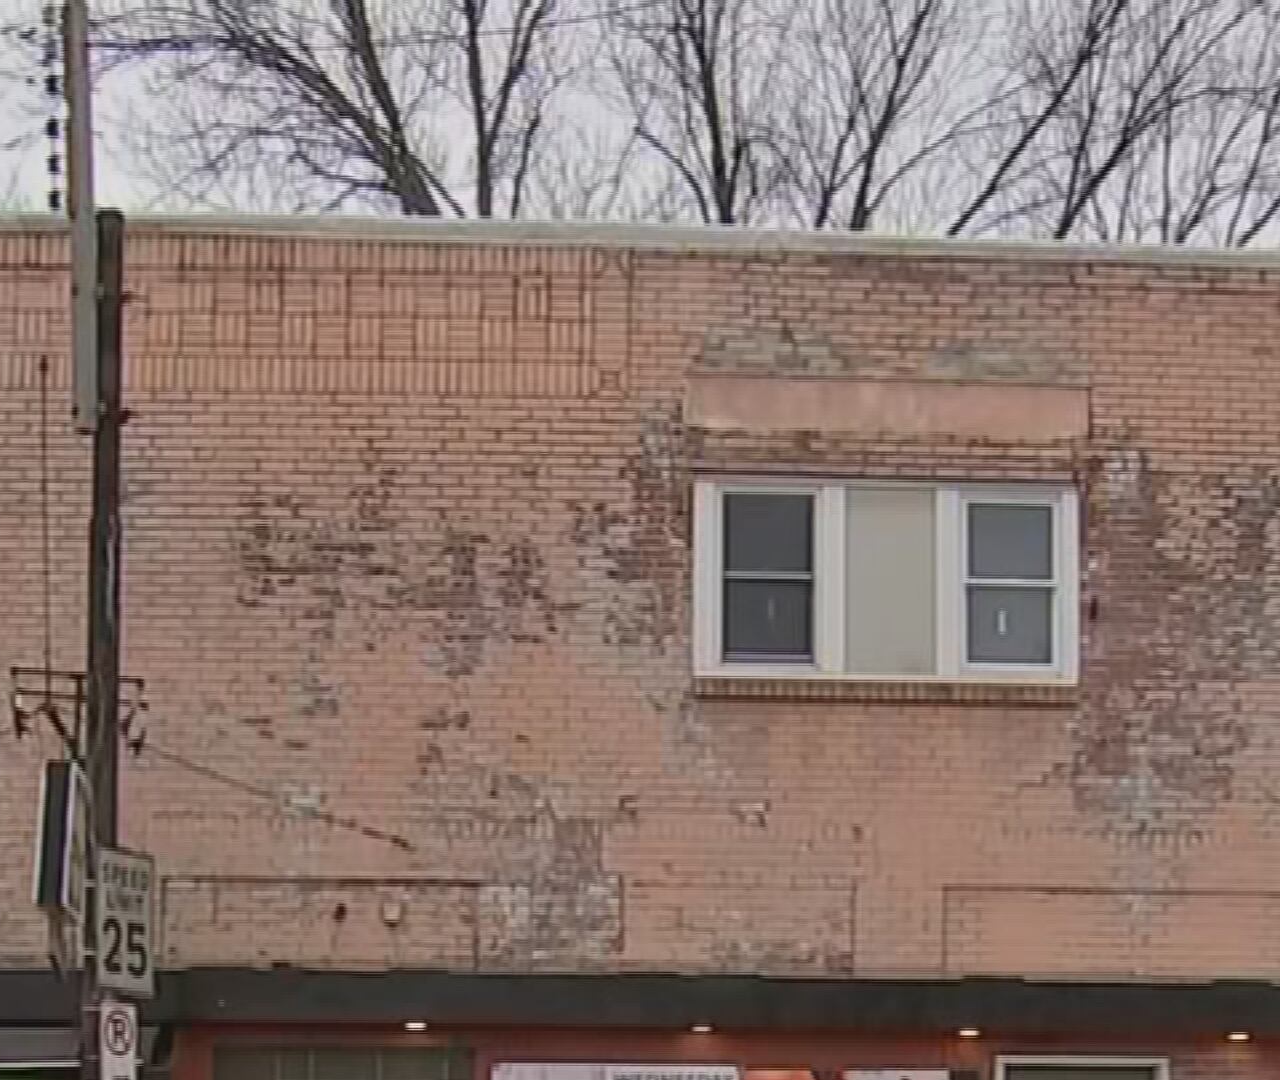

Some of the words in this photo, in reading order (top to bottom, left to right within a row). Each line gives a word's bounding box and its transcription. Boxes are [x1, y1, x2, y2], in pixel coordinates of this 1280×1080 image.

[102, 861, 149, 892] SPEED
[105, 887, 145, 914] LIMIT
[102, 917, 148, 979] 25
